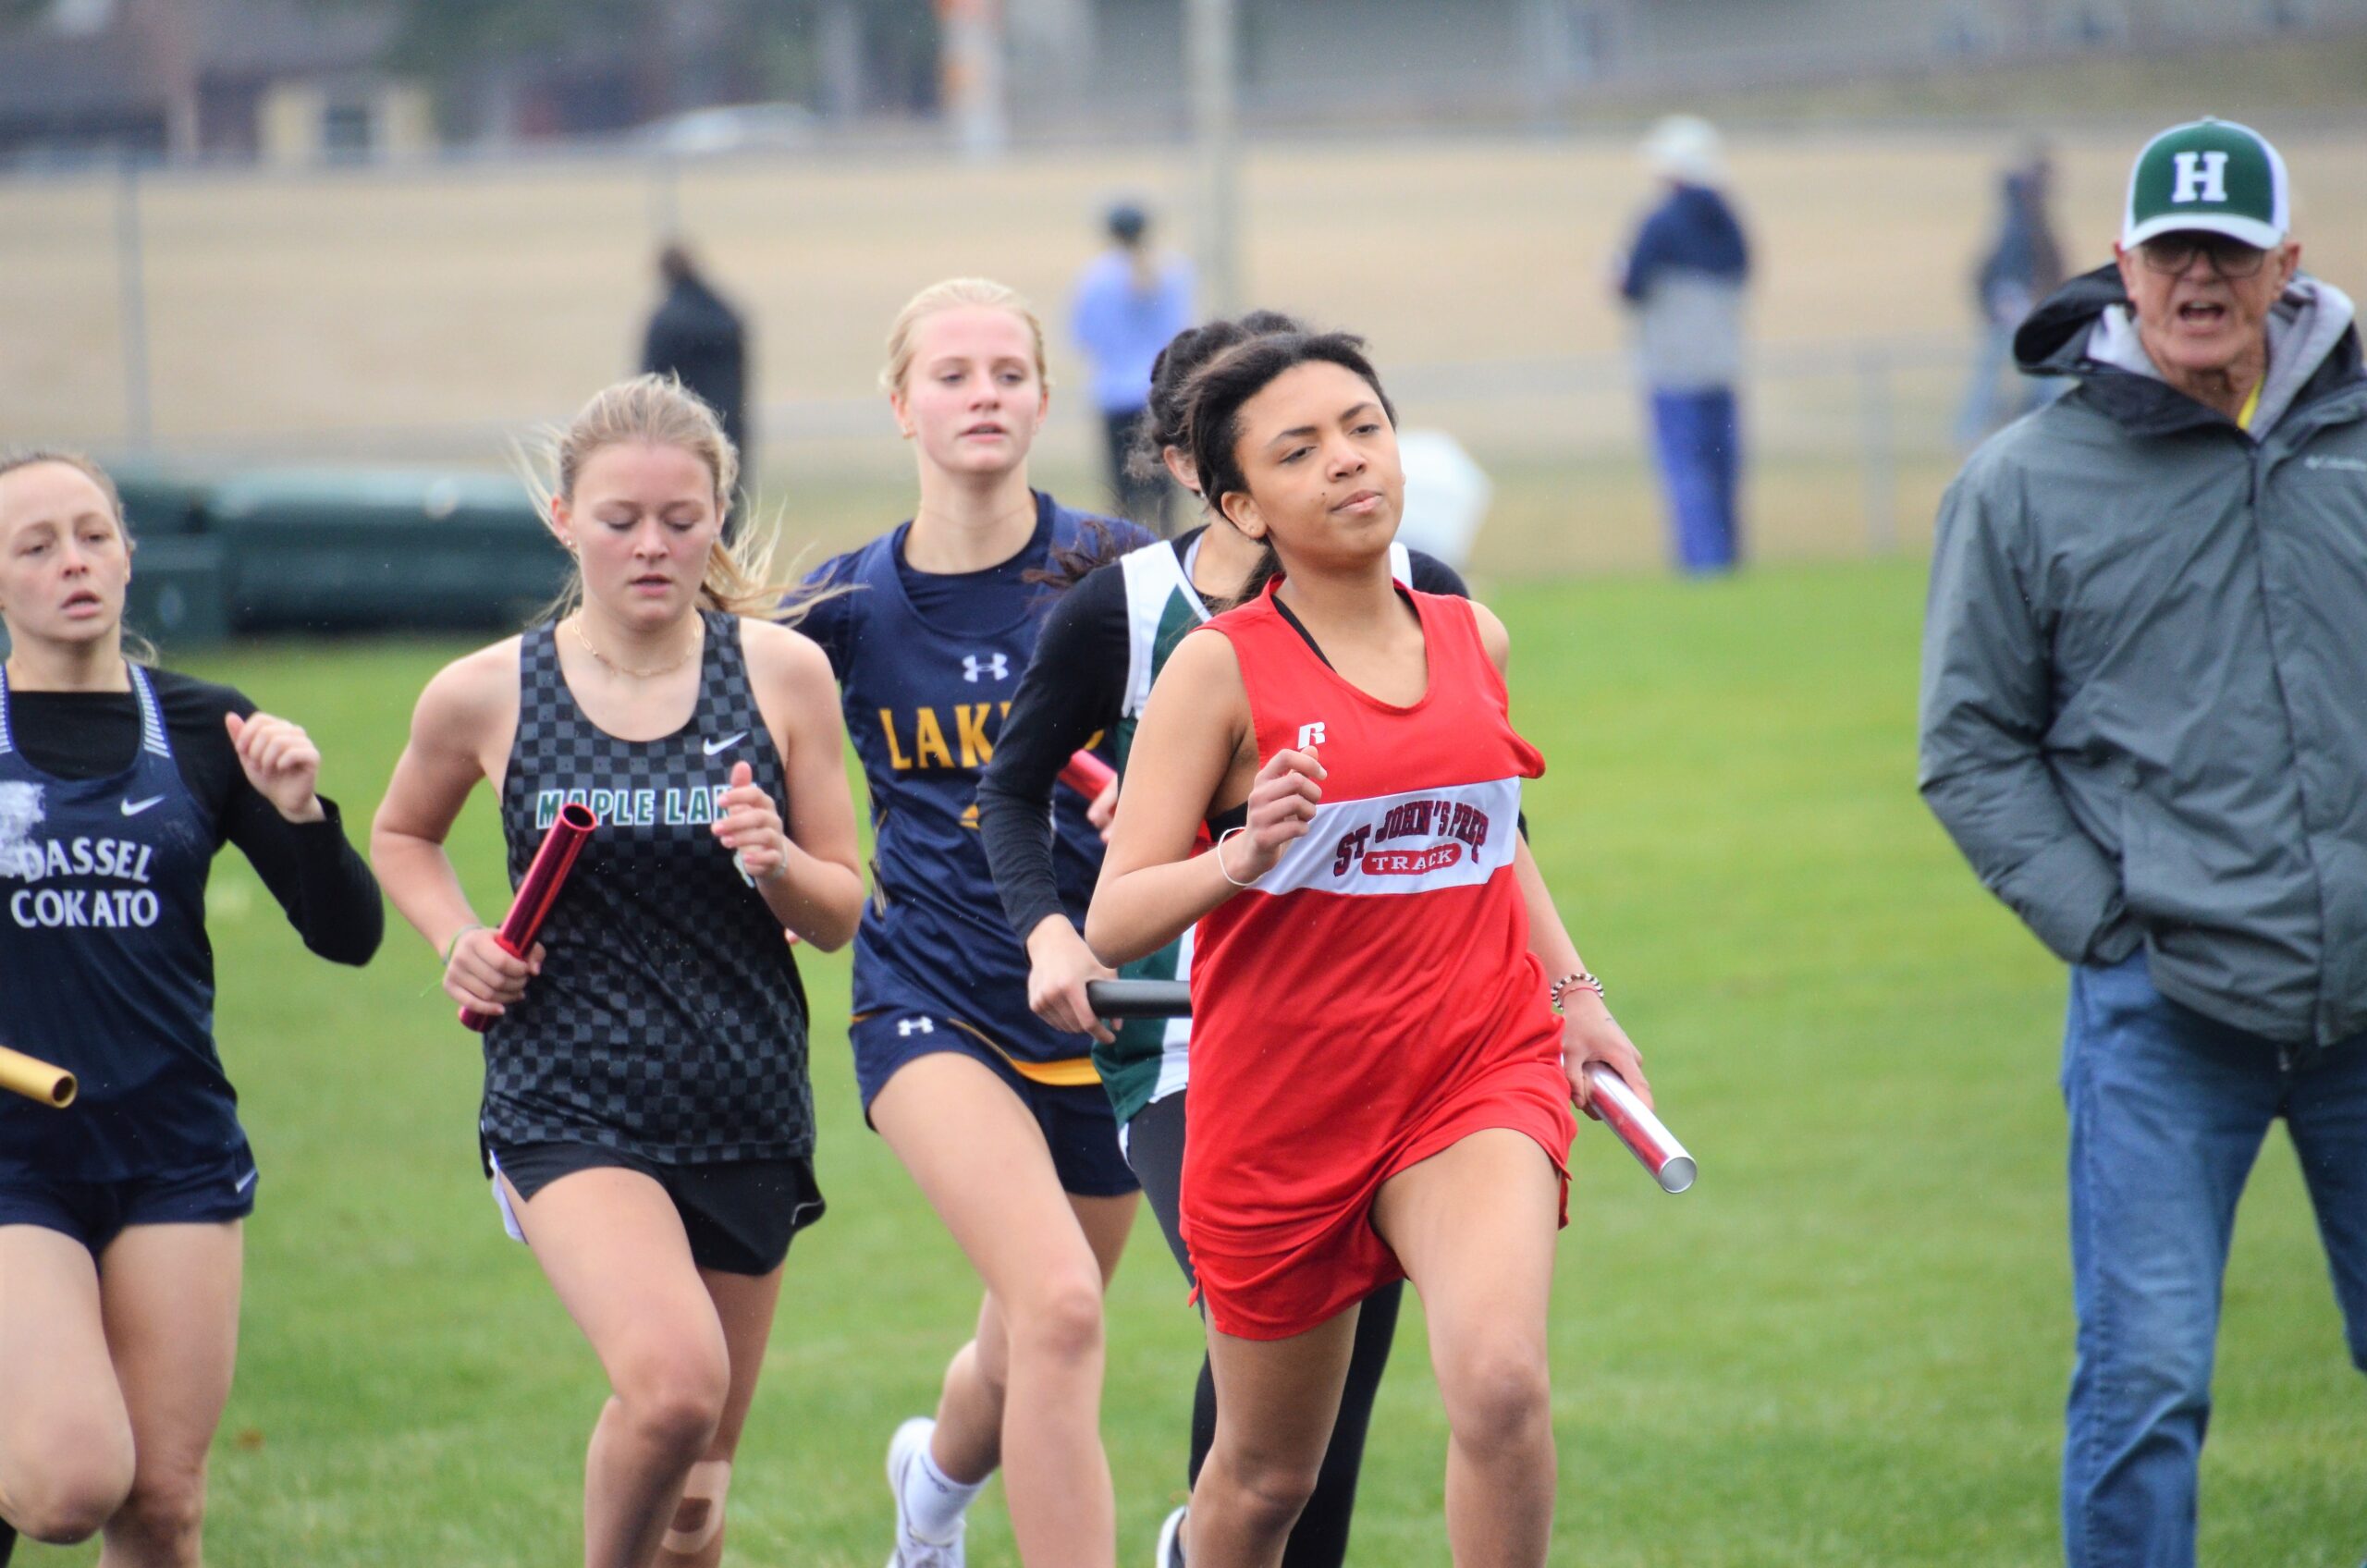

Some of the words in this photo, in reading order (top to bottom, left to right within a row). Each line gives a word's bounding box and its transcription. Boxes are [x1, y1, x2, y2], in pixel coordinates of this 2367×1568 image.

[2172, 152, 2228, 202] H
[879, 701, 1013, 769] LAK
[665, 782, 757, 826] LAK
[1375, 800, 1452, 843] JOHN'S
[1448, 802, 1490, 864] PREP
[17, 836, 153, 884] DASSEL
[1371, 849, 1454, 872] TRACK
[10, 888, 159, 928] COKATO
